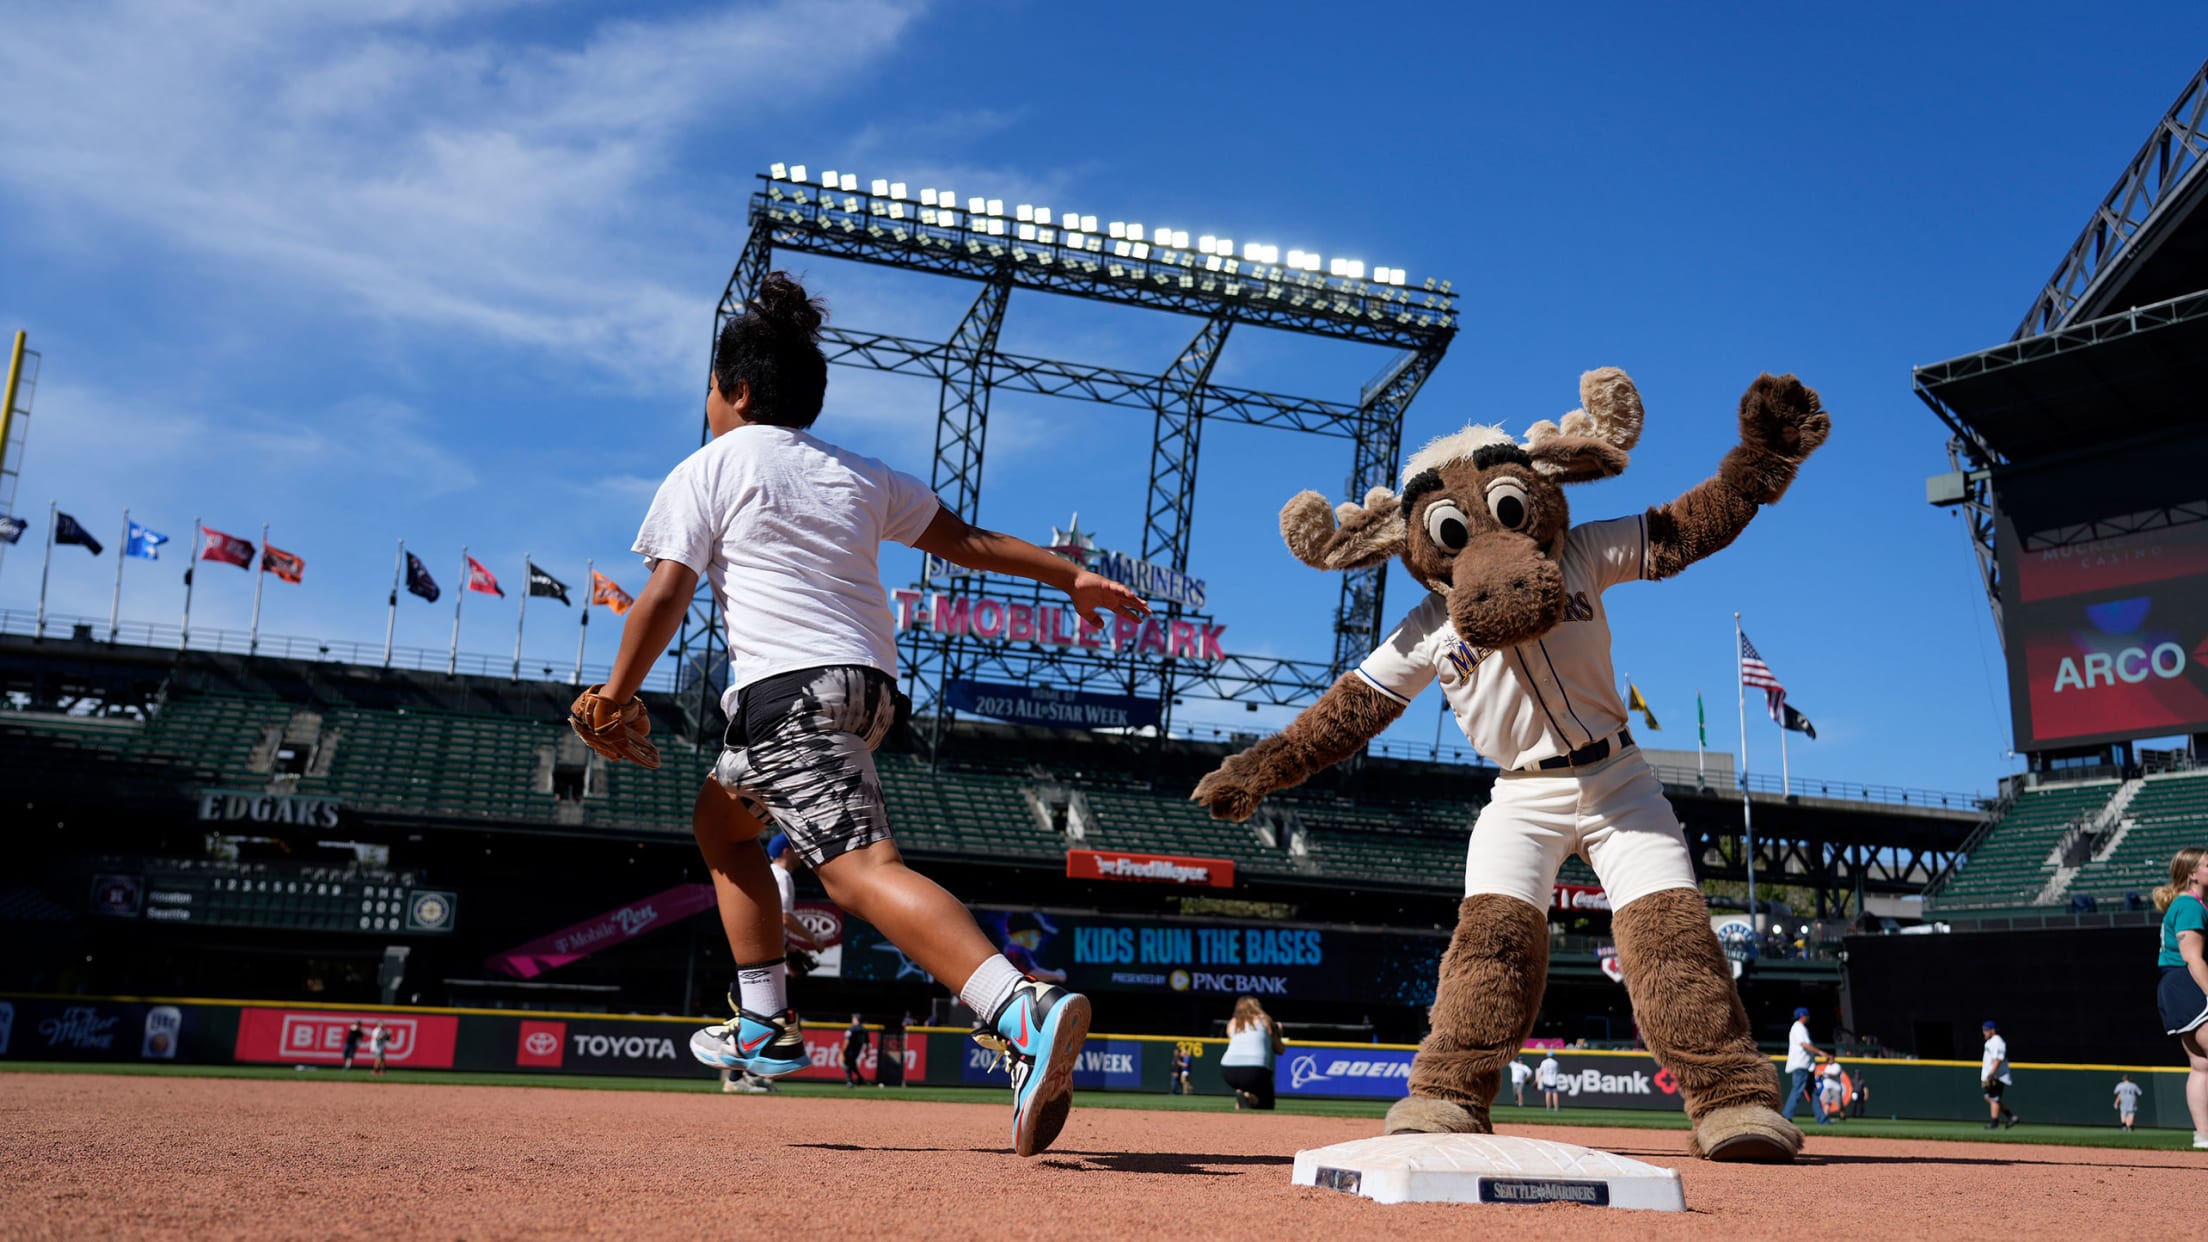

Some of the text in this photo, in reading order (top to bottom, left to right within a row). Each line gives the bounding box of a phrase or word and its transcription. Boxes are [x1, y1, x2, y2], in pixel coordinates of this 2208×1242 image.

[1100, 551, 1207, 605] MARINERS
[892, 589, 1227, 661] T-MOBILE PARK
[2053, 642, 2186, 693] ARCO
[975, 696, 1013, 715] 2023
[1086, 705, 1128, 726] WEEK
[1074, 927, 1323, 966] KIDS RUN THE BASES
[1112, 972, 1156, 984] PRESENTED
[1192, 972, 1233, 991] PNC
[1235, 974, 1288, 994] BANK
[573, 1035, 677, 1060] TOYOTA
[1086, 1051, 1133, 1072] WEEK
[1326, 1061, 1412, 1078] BOEIN
[1494, 1183, 1596, 1202] SEATTLE MARINERS
